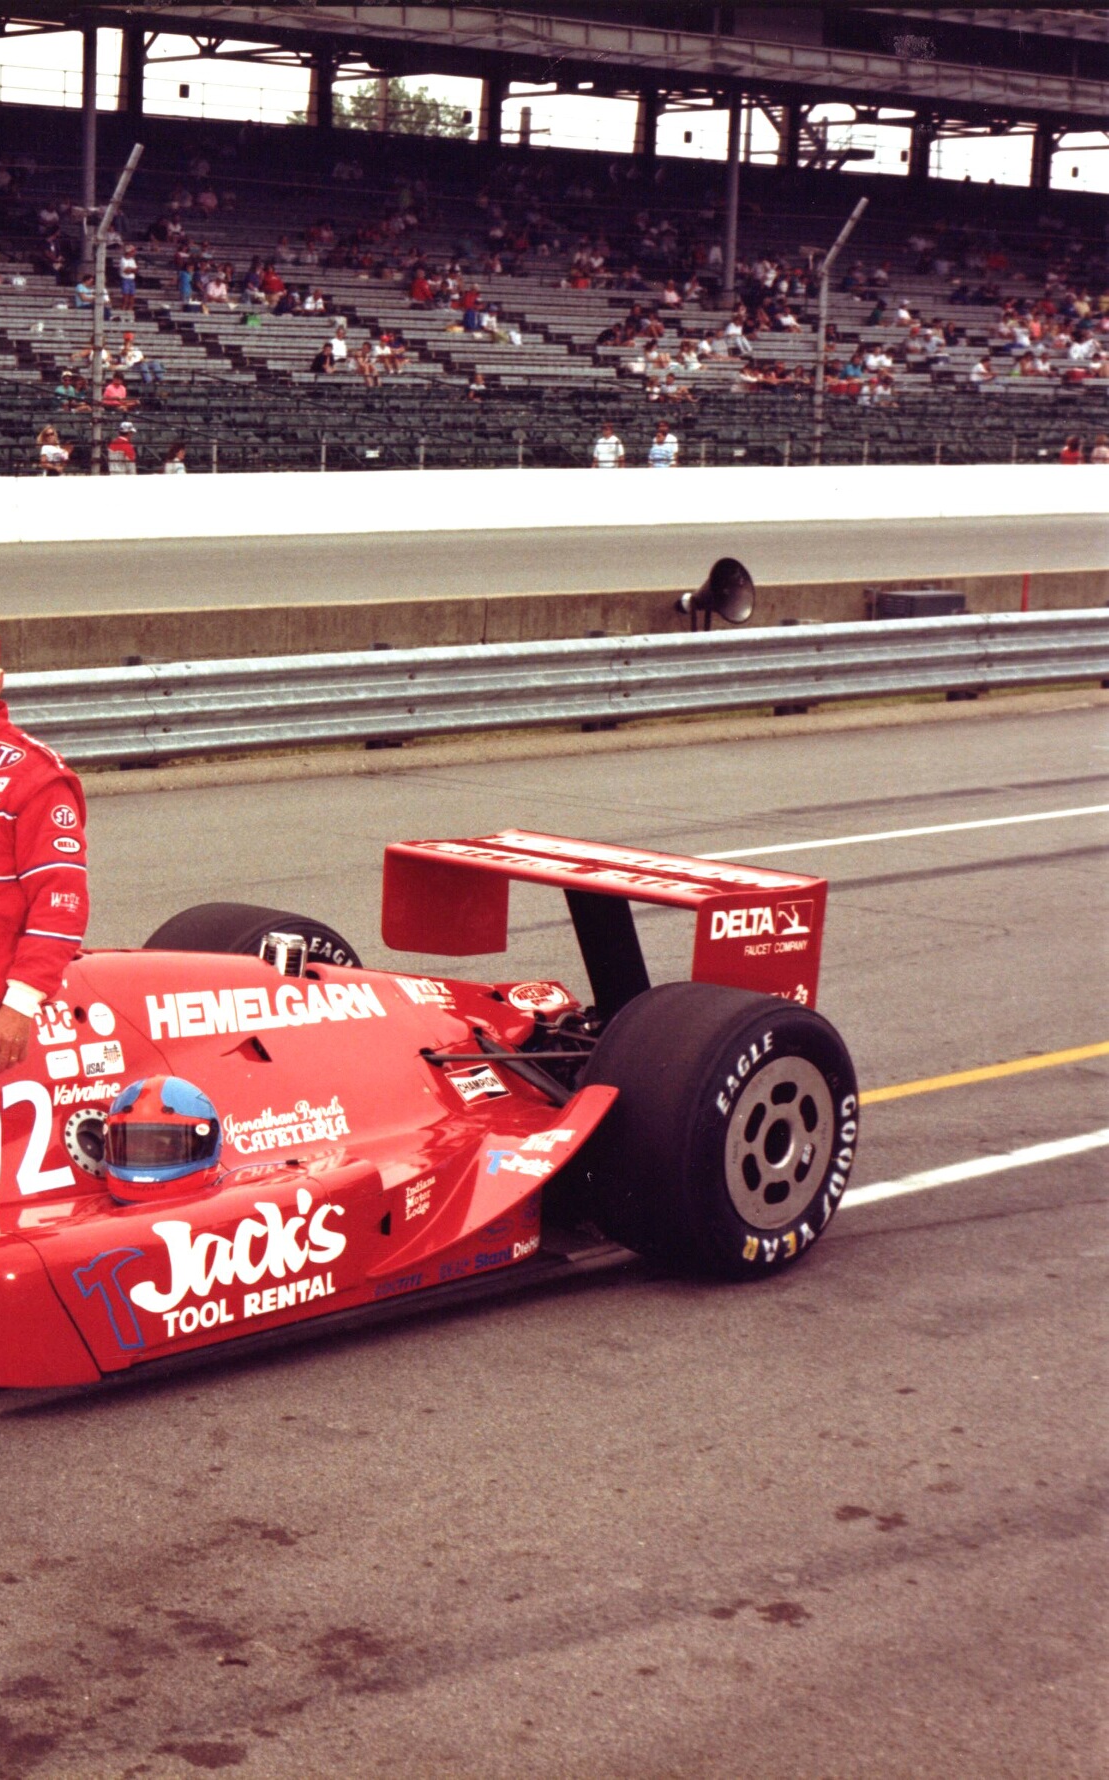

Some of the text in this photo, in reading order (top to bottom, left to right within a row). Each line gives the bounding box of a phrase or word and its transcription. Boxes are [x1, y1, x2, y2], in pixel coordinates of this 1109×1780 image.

[54, 808, 75, 824] STP
[56, 840, 77, 850] BELL
[710, 907, 775, 940] DELTA
[744, 940, 809, 956] FAUCET COMPANY
[145, 983, 387, 1040] HEMELGARN
[86, 1061, 106, 1076] USAC
[716, 1030, 775, 1116] EAGLE
[53, 1080, 121, 1107] Valvoline
[457, 1074, 501, 1095] CHAMPION
[223, 1095, 345, 1144] Jonathan Byrd's
[234, 1114, 351, 1154] CAFETERIA
[405, 1175, 436, 1198] Indiana
[405, 1202, 430, 1221] Lodge
[406, 1189, 432, 1210] Motor
[129, 1187, 347, 1314] Jack's
[163, 1299, 234, 1338] TOOL
[243, 1272, 336, 1319] RENTAL
